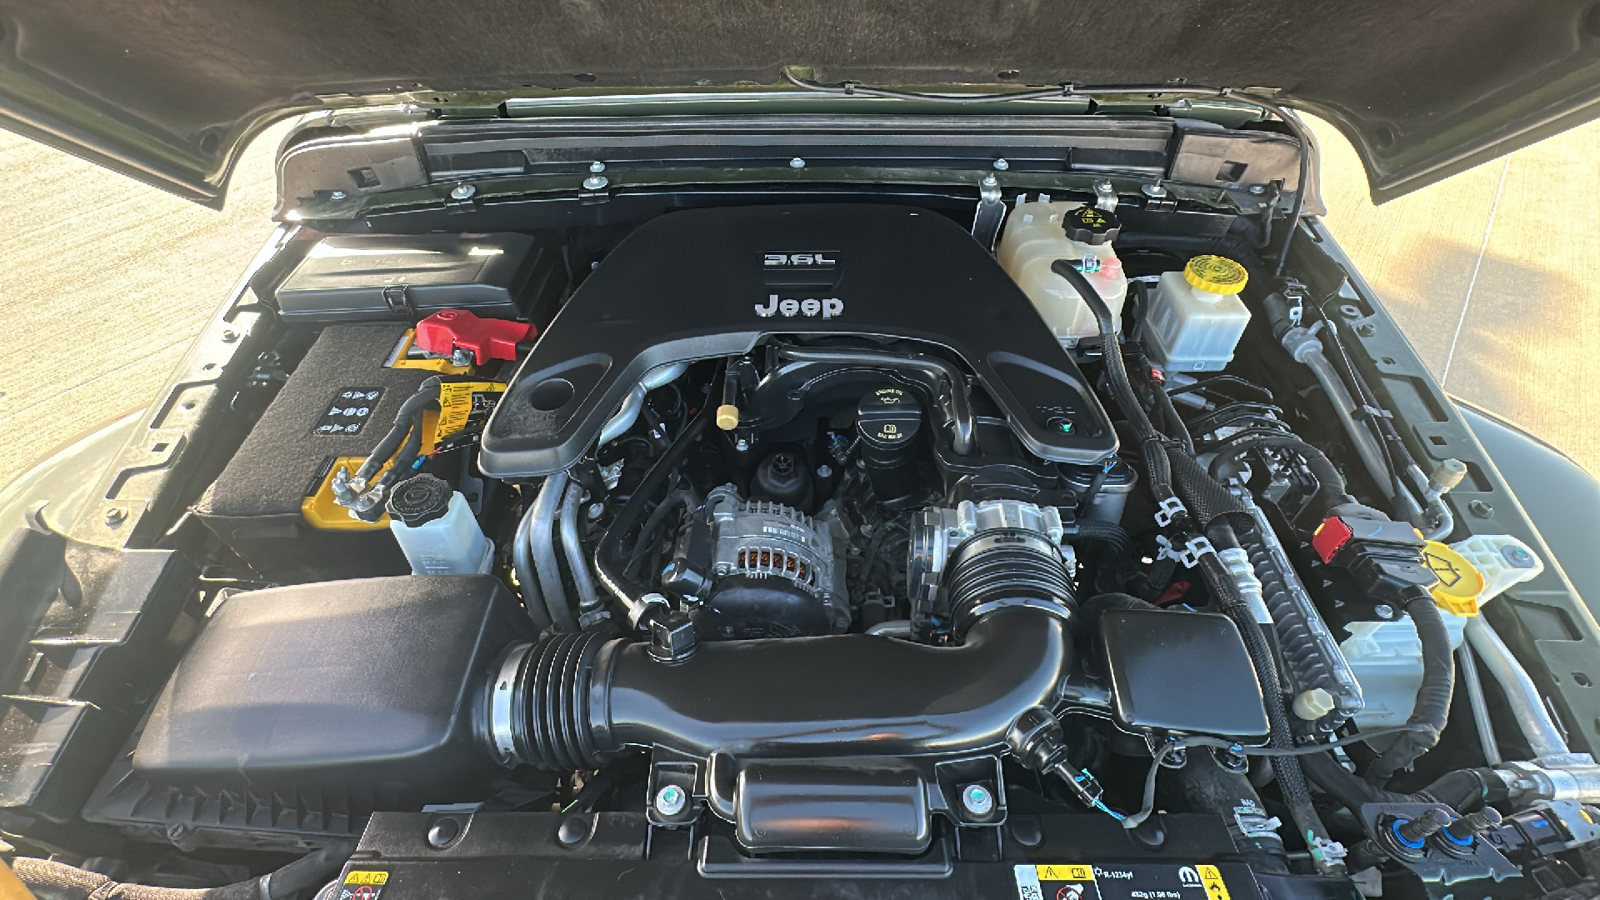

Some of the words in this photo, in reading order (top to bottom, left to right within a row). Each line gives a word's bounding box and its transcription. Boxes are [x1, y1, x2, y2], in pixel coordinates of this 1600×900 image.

[764, 254, 836, 266] 3.6L
[754, 294, 844, 320] Jeep
[875, 388, 894, 396] ENGINE
[1103, 871, 1134, 880] R-1234yf
